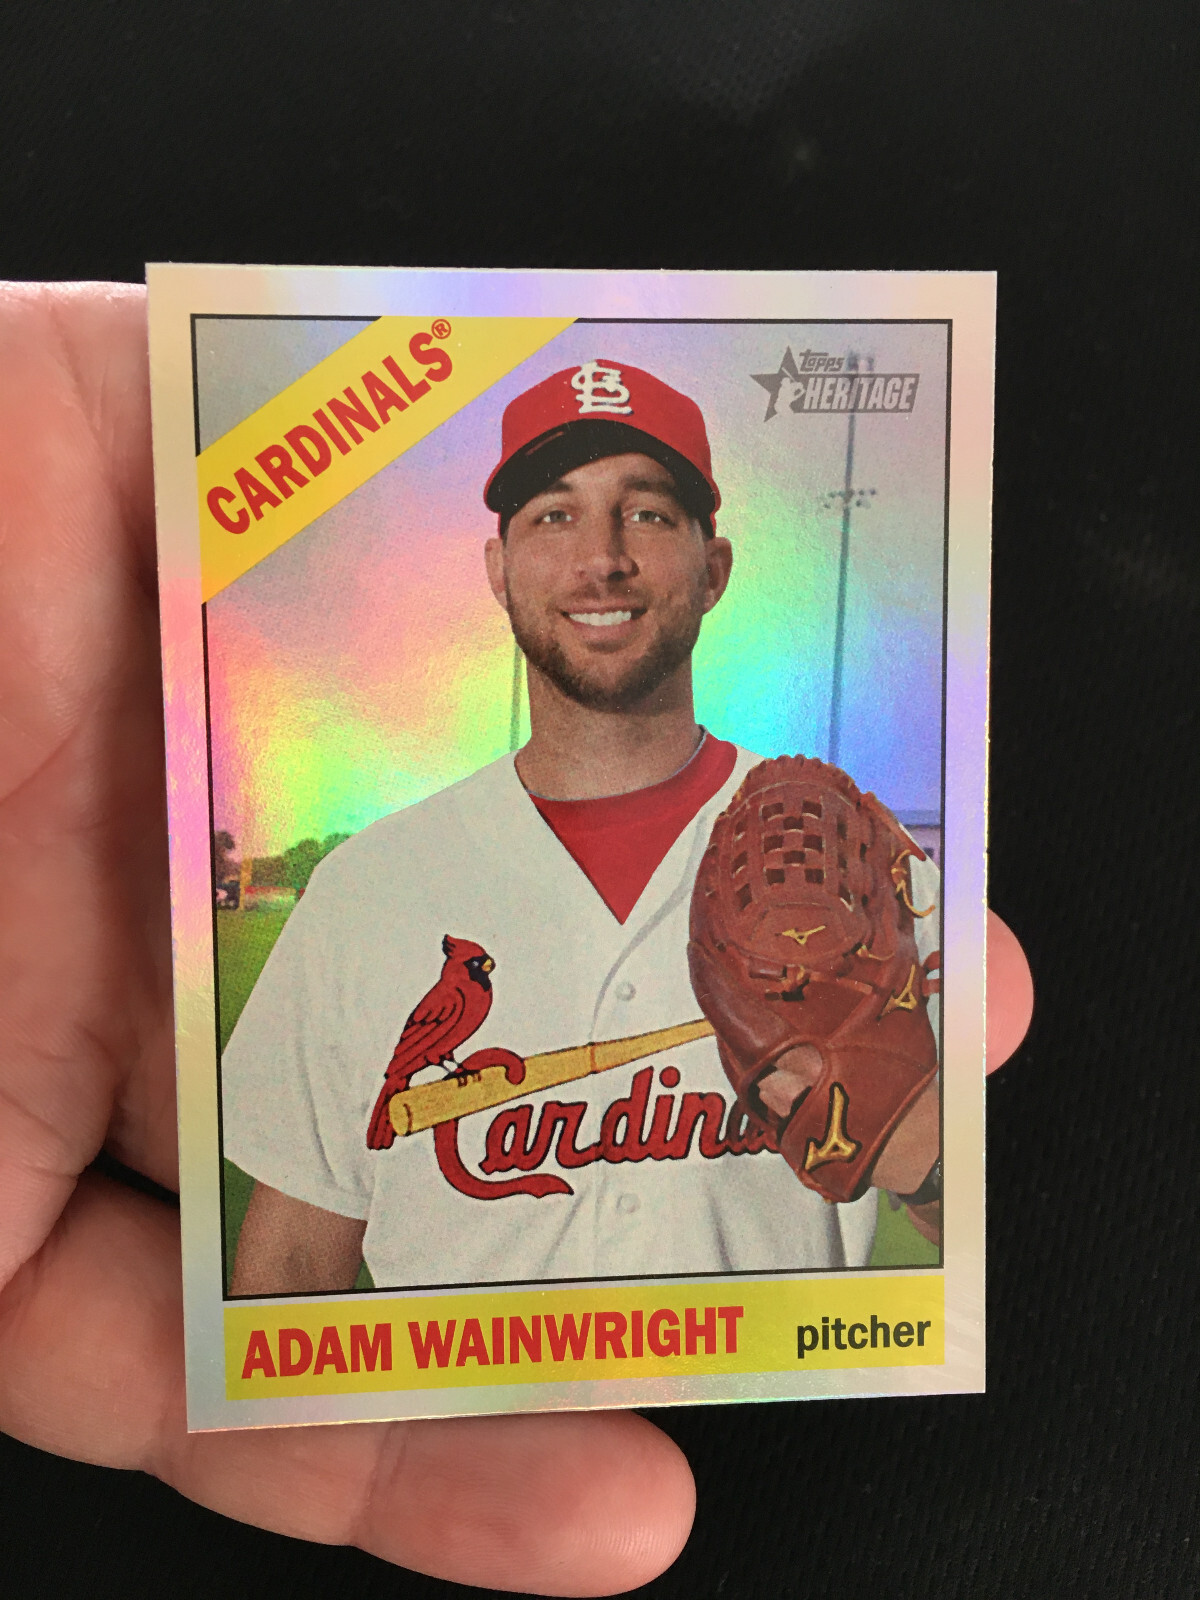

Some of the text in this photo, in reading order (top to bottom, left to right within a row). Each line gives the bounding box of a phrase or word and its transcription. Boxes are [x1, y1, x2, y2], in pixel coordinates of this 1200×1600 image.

[803, 376, 916, 410] HERITAGE
[241, 1305, 744, 1380] ADAM WAINWRIGHT
[797, 1314, 931, 1360] pitcher
